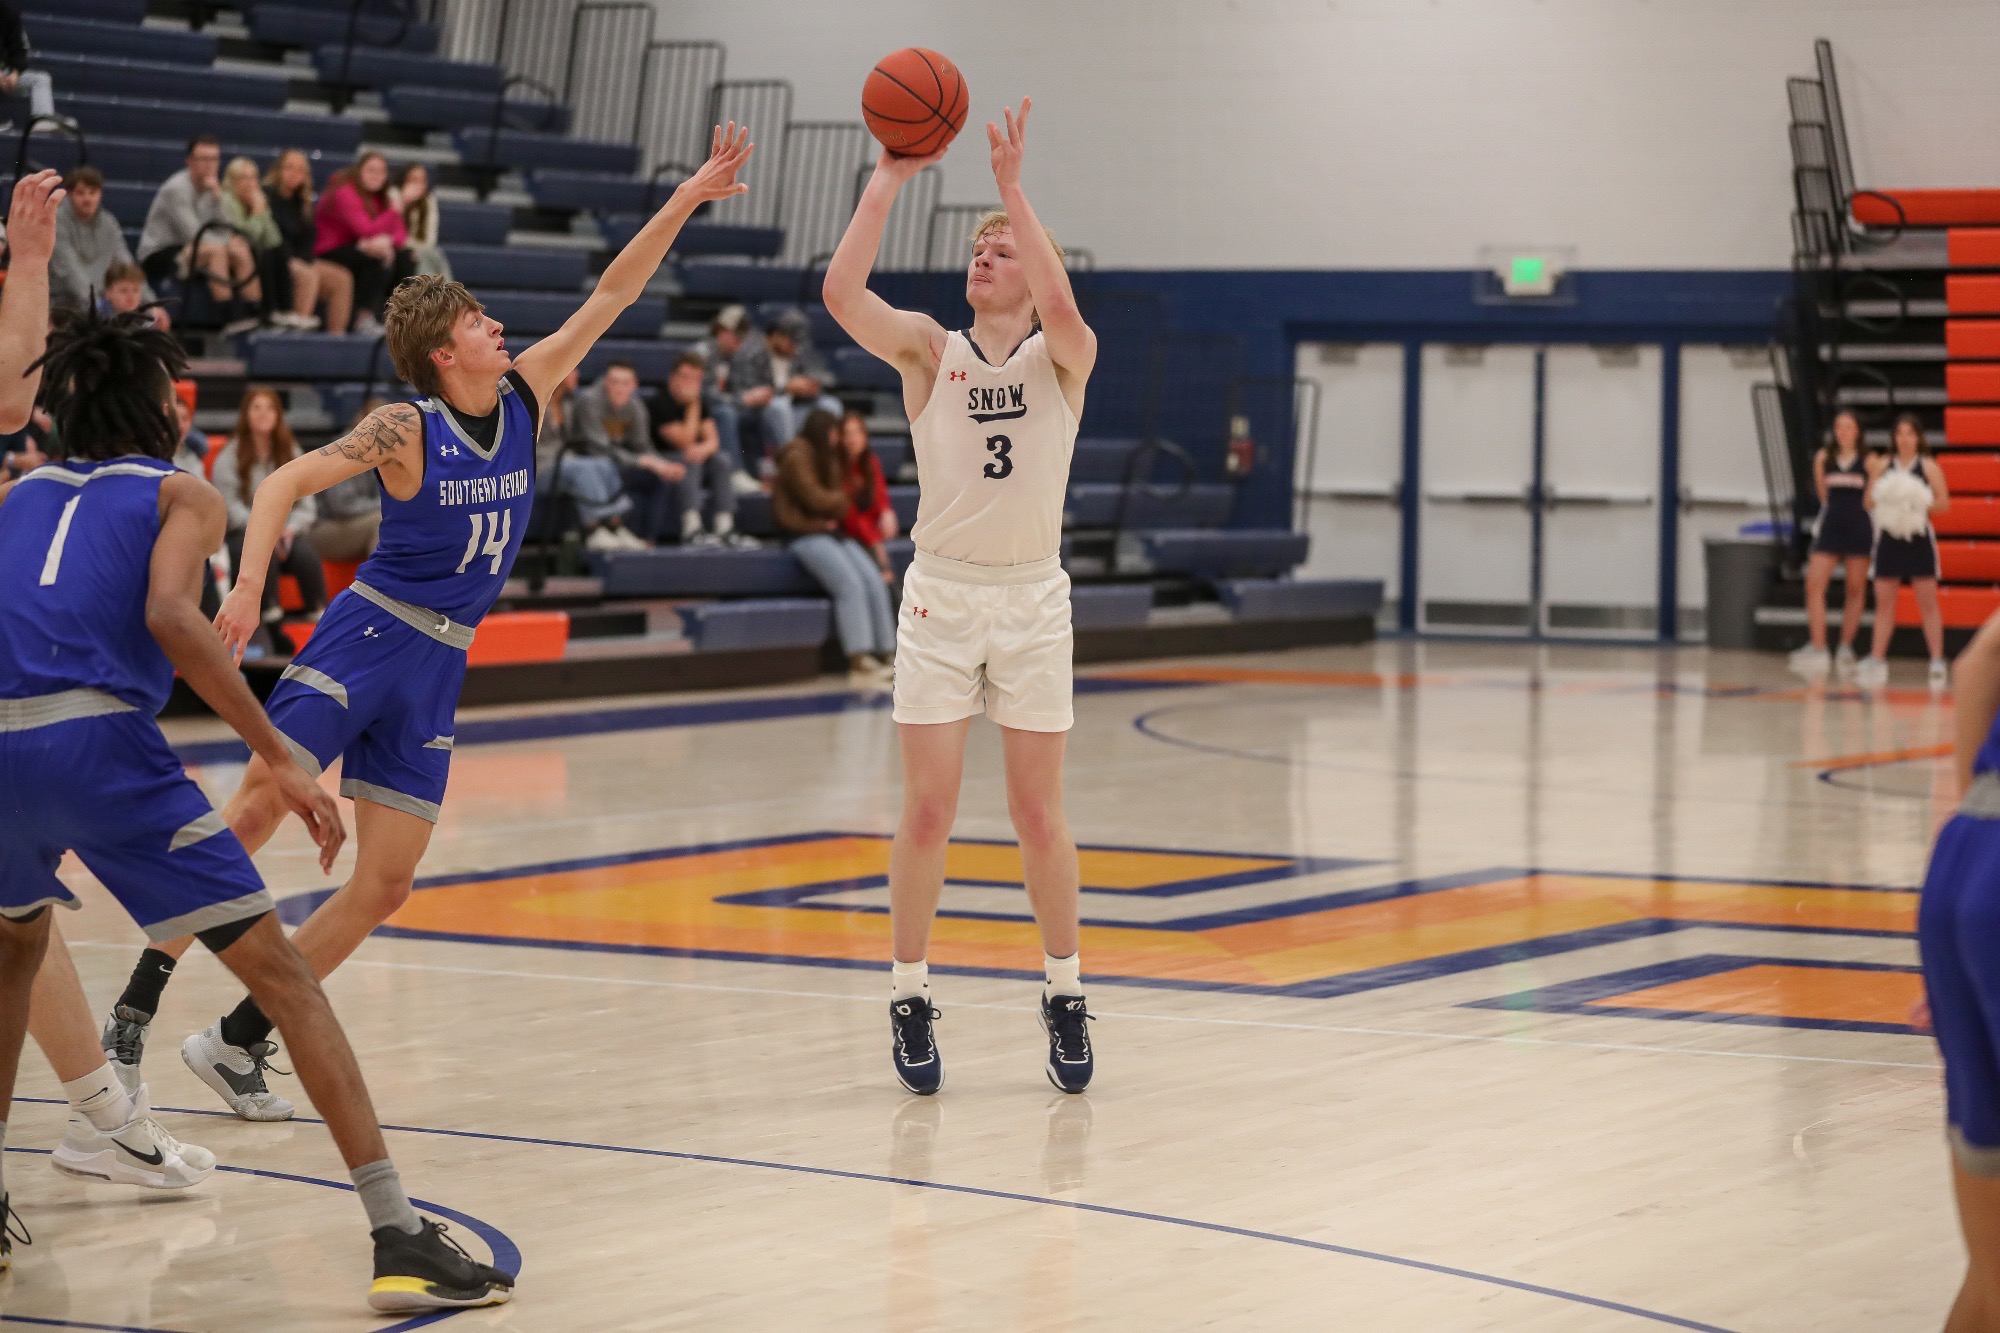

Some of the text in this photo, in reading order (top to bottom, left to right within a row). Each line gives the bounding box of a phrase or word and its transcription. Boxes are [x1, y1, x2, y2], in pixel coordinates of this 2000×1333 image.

[968, 383, 1025, 411] SNOW
[983, 434, 1014, 480] 3
[439, 468, 528, 506] SOUTHERN NEVADA
[39, 494, 82, 587] 1
[455, 508, 511, 575] 14
